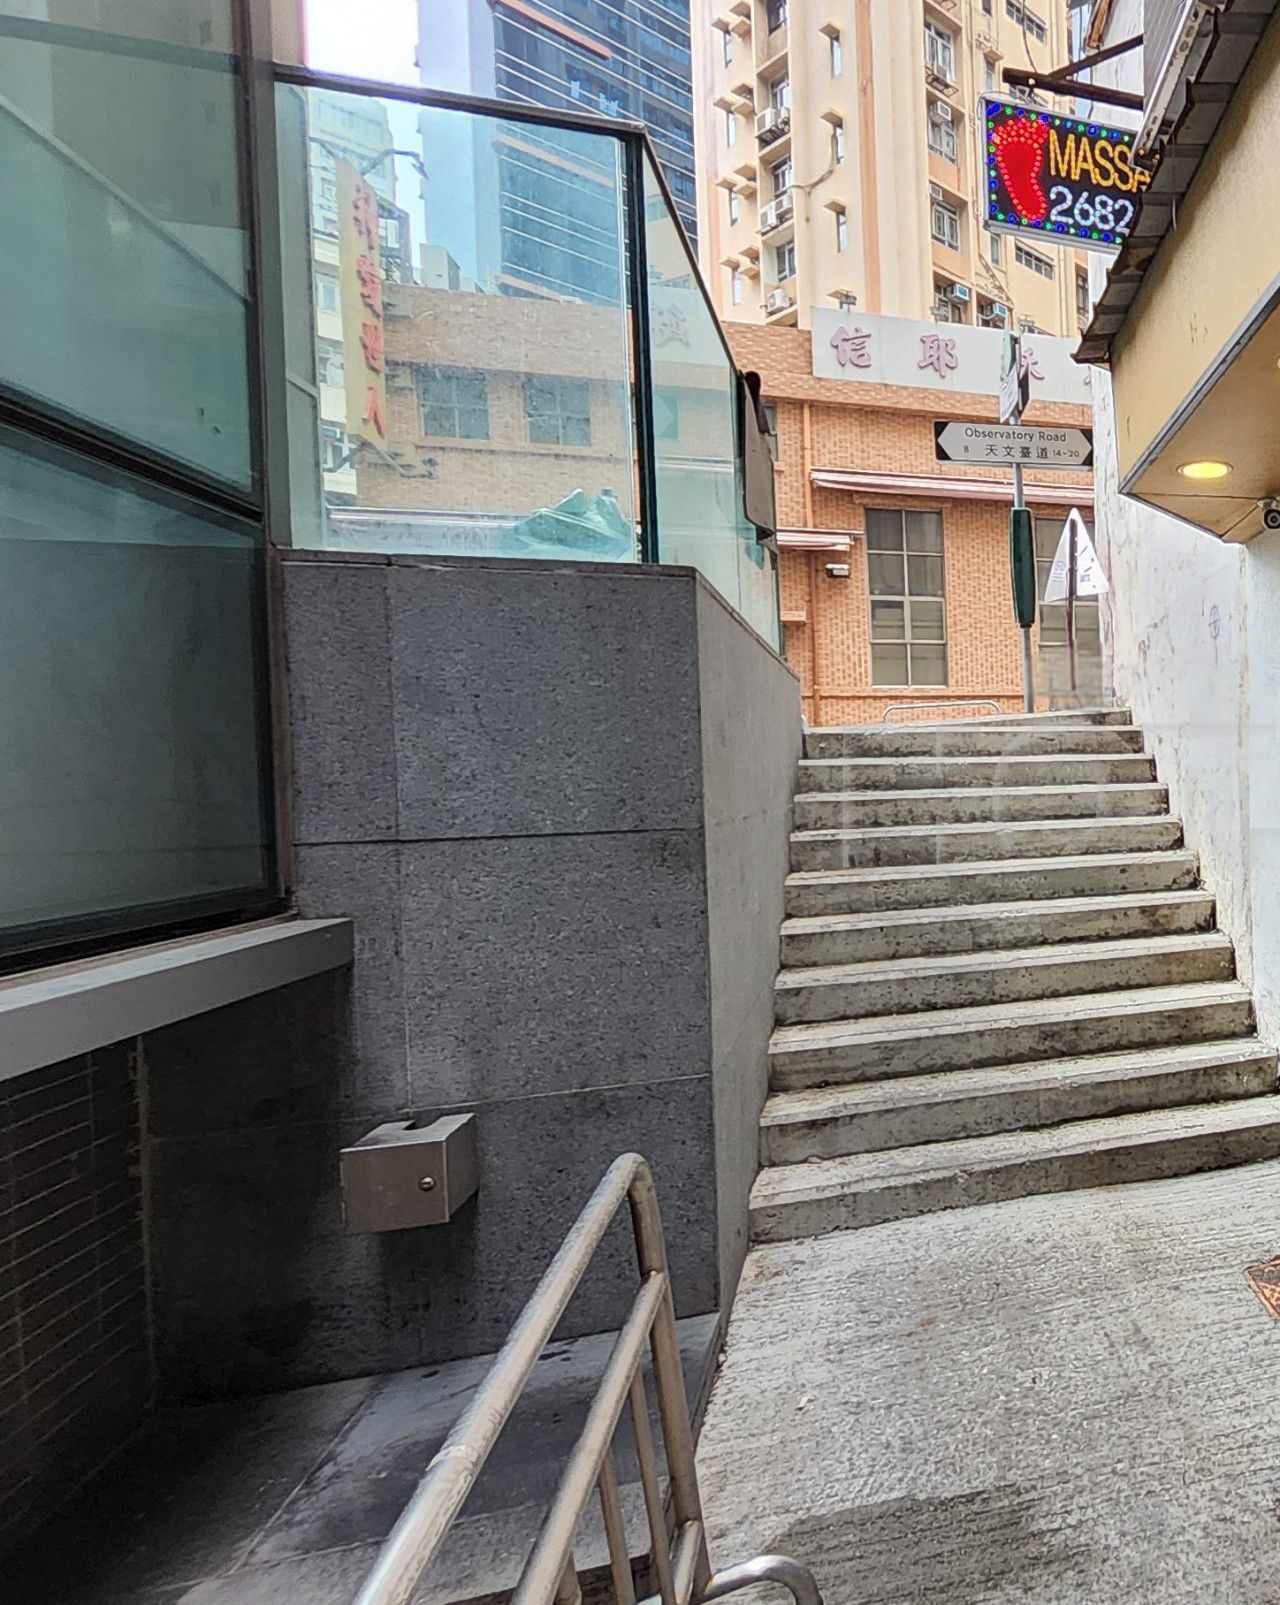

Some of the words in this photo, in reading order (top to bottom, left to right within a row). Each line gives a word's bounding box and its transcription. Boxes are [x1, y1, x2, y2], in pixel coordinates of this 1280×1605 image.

[1049, 184, 1134, 238] 2682
[964, 427, 1034, 442] Observatory
[1038, 431, 1067, 442] Road
[984, 443, 1049, 459] 天文臺道
[1052, 449, 1080, 458] 14-20
